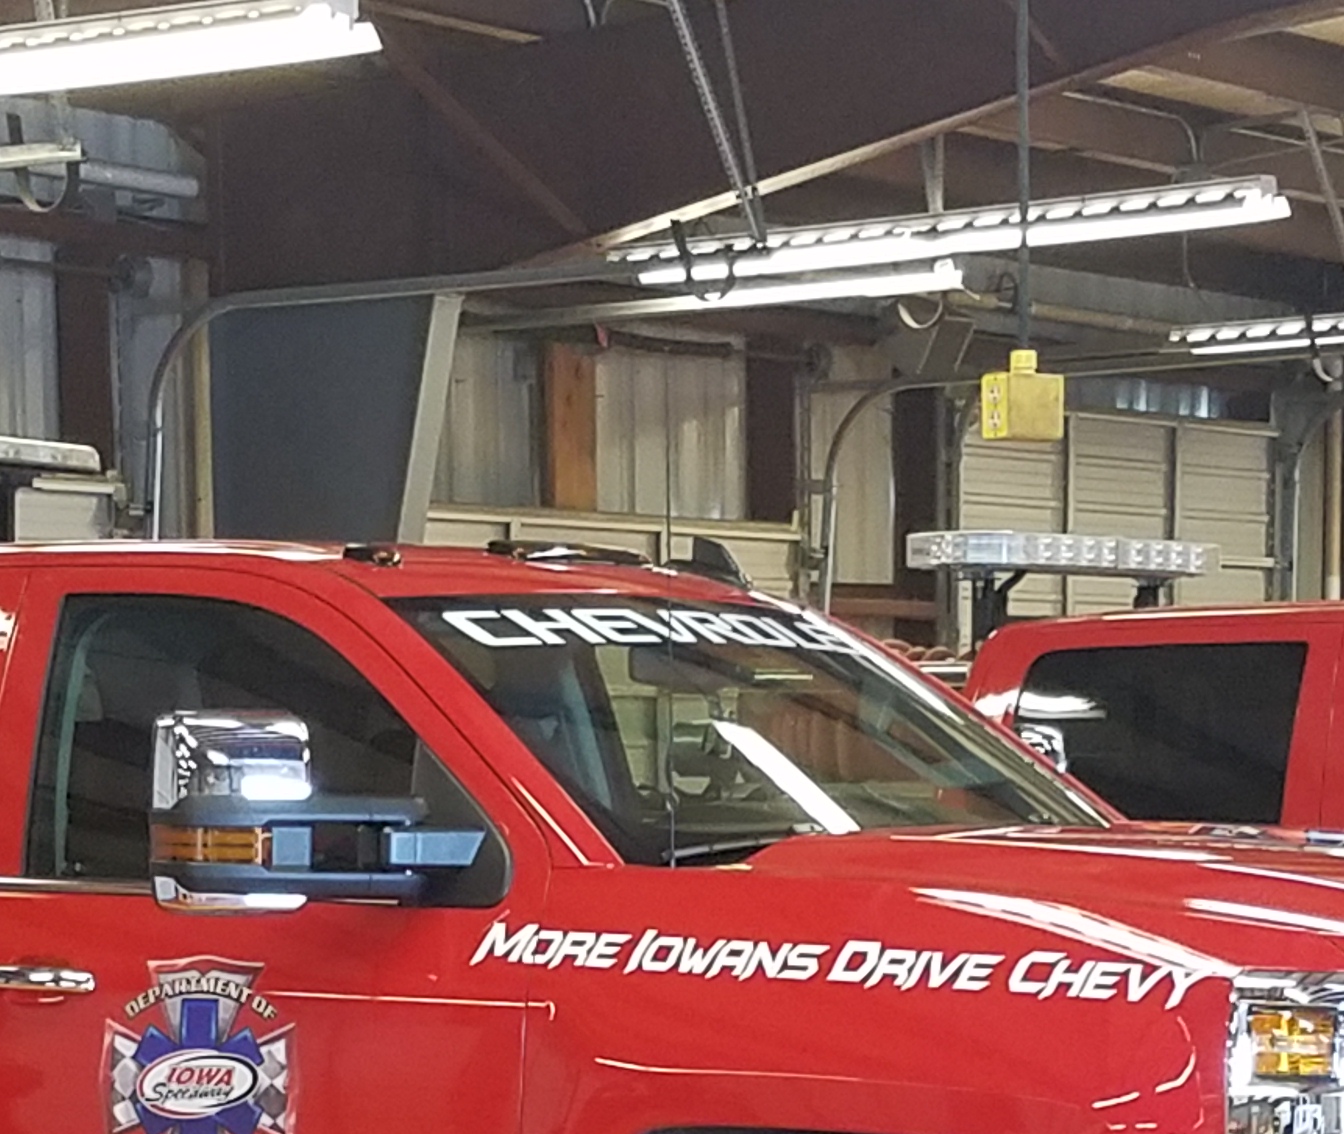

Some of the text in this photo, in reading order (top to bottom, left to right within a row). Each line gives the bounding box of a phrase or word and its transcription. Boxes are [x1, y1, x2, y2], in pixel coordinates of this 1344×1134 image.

[442, 608, 859, 655] CHEVROLE
[124, 976, 278, 1020] DEPARTMENT OF
[167, 1066, 235, 1086] IOWA
